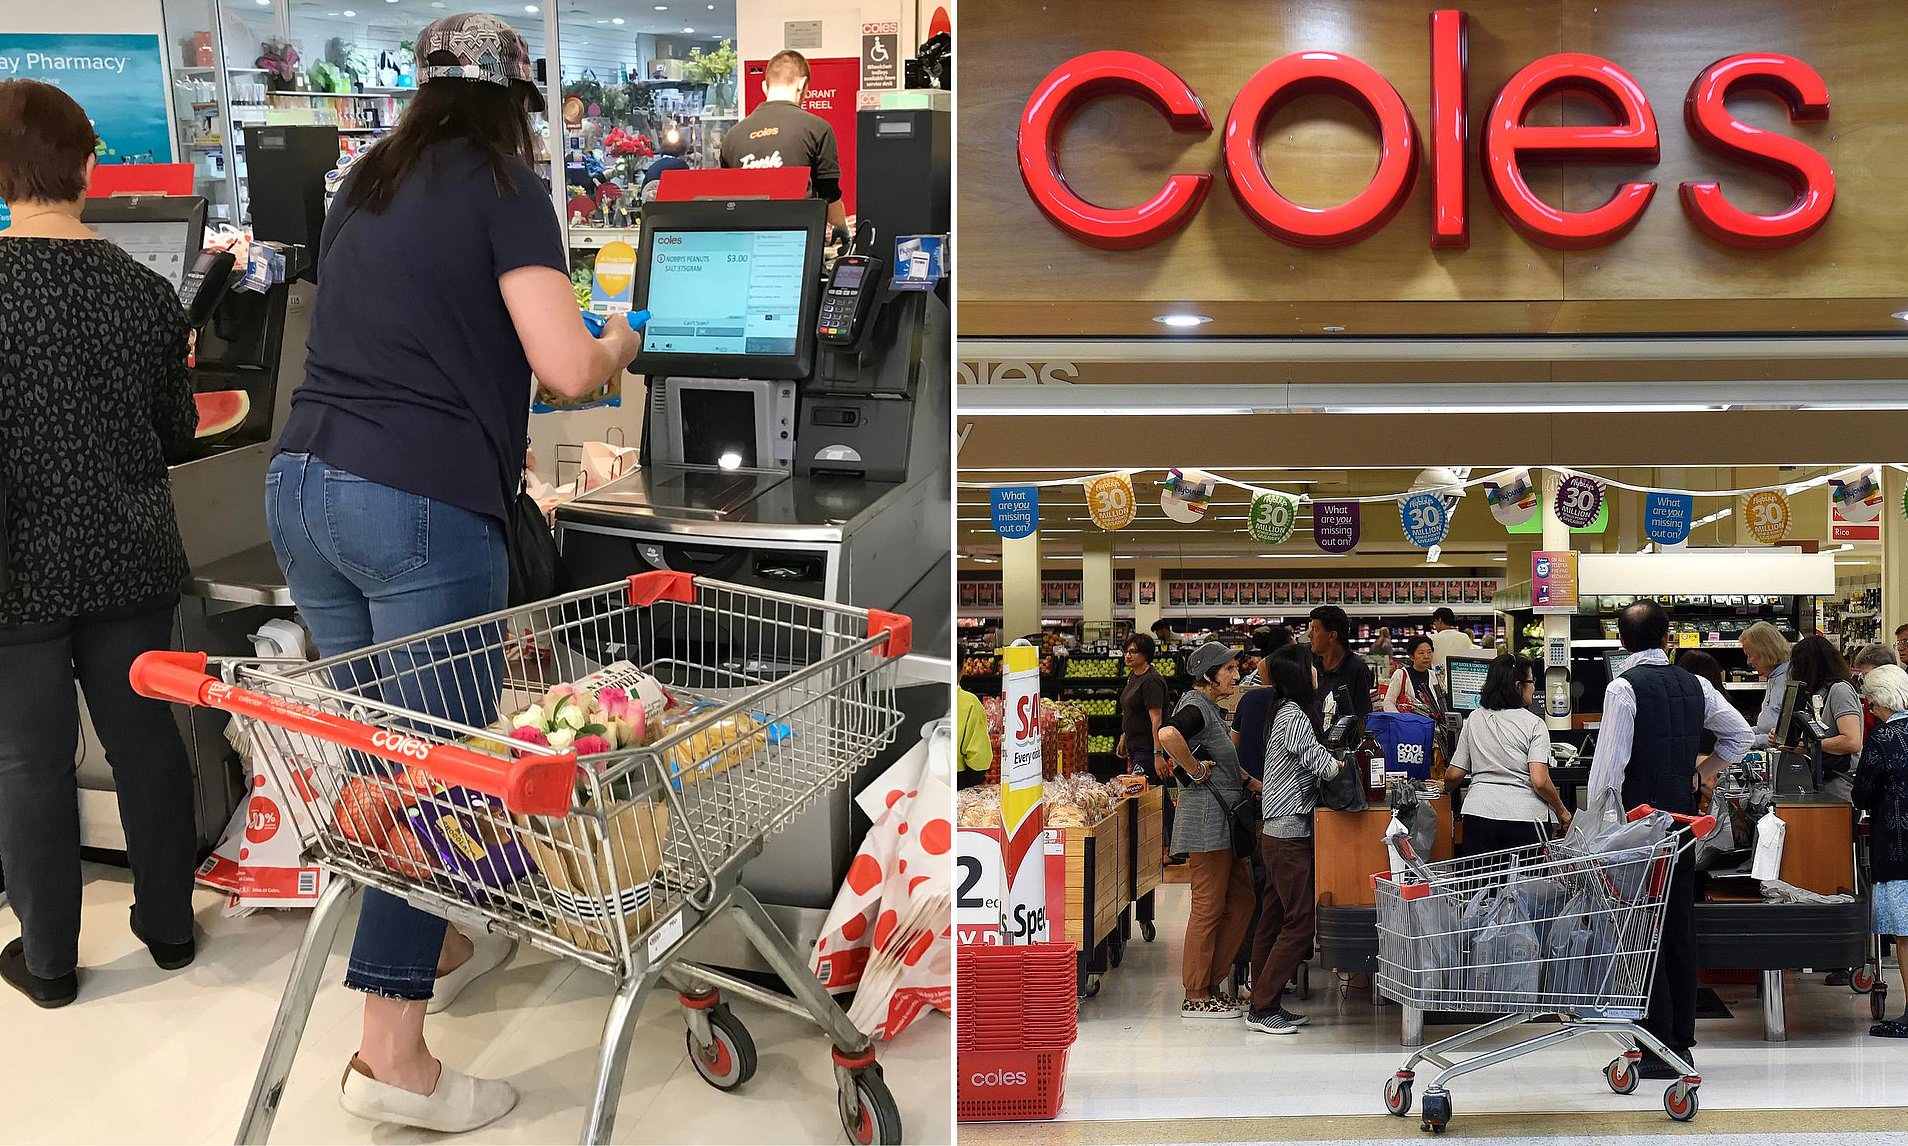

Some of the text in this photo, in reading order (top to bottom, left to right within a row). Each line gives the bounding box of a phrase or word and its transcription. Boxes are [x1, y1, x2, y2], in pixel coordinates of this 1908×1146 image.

[863, 23, 897, 33] coles
[0, 53, 126, 73] ay Pharmacy
[806, 89, 836, 98] DRANT
[809, 101, 832, 109] REEL
[750, 127, 779, 139] coles
[1017, 9, 1835, 250] coles
[657, 236, 682, 245] coles
[727, 254, 748, 262] $3.00
[1571, 479, 1595, 492] flybuys
[1001, 491, 1026, 501] What
[1097, 489, 1127, 512] 30
[1563, 487, 1595, 511] 30
[998, 502, 1031, 512] are you
[1658, 497, 1681, 507] What
[1100, 508, 1129, 519] MILLION
[1323, 505, 1348, 514] What
[1561, 506, 1591, 518] MILLION
[1653, 508, 1684, 518] are you
[1753, 503, 1782, 526] 30
[998, 512, 1030, 523] missing
[1257, 504, 1288, 527] 30
[1320, 516, 1352, 526] are you
[1409, 506, 1440, 530] 30
[1000, 523, 1031, 533] out on?
[1256, 523, 1286, 533] MILLION
[1652, 518, 1683, 530] missing
[1754, 523, 1785, 533] MILLION
[1321, 526, 1352, 537] missing
[1412, 525, 1442, 536] MILLION
[1652, 530, 1682, 539] out on?
[1337, 536, 1352, 546] on?
[1015, 692, 1040, 741] SA
[371, 729, 434, 760] coles
[1397, 743, 1424, 754] COOL
[1014, 750, 1032, 765] Every
[1397, 752, 1424, 764] BAG
[1013, 903, 1046, 945] Spec
[970, 1068, 1027, 1087] coles
